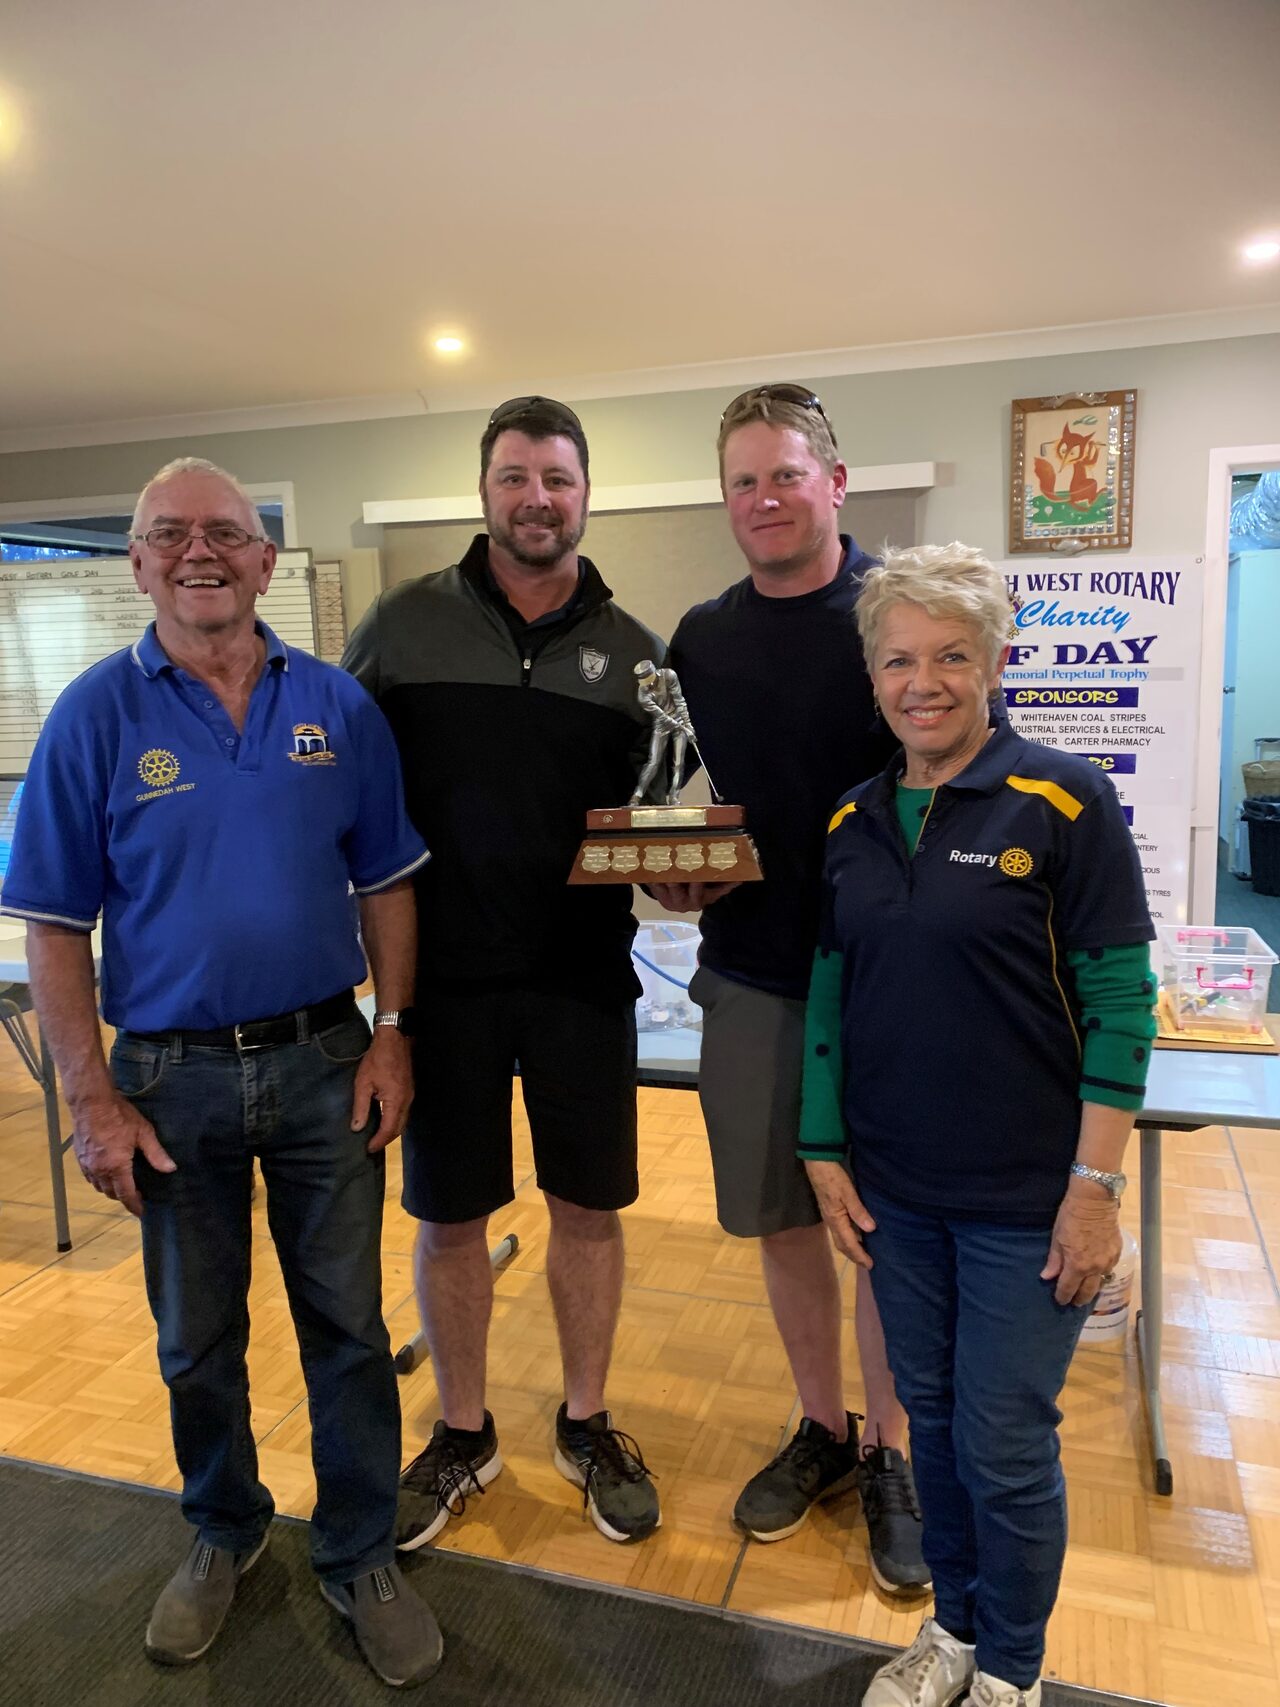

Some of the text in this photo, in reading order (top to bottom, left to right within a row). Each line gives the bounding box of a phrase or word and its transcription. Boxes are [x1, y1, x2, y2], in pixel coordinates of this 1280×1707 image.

[1026, 573, 1083, 592] WEST
[1089, 571, 1181, 605] ROTARY
[1015, 600, 1131, 634] Charity
[1053, 635, 1158, 665] DAY
[1051, 669, 1105, 682] Perpetual
[1110, 669, 1150, 682] Trophy
[1015, 690, 1119, 704] SPONSORS
[1021, 714, 1078, 722] WHITEHAVEN
[1080, 714, 1105, 722] COAL
[1110, 714, 1147, 722] STRIPES
[1058, 726, 1101, 734] SERVICES
[1111, 726, 1166, 734] ELECTRICAL
[1101, 738, 1151, 746] PHARMACY
[175, 783, 196, 792] WEST
[949, 849, 998, 867] Rotary
